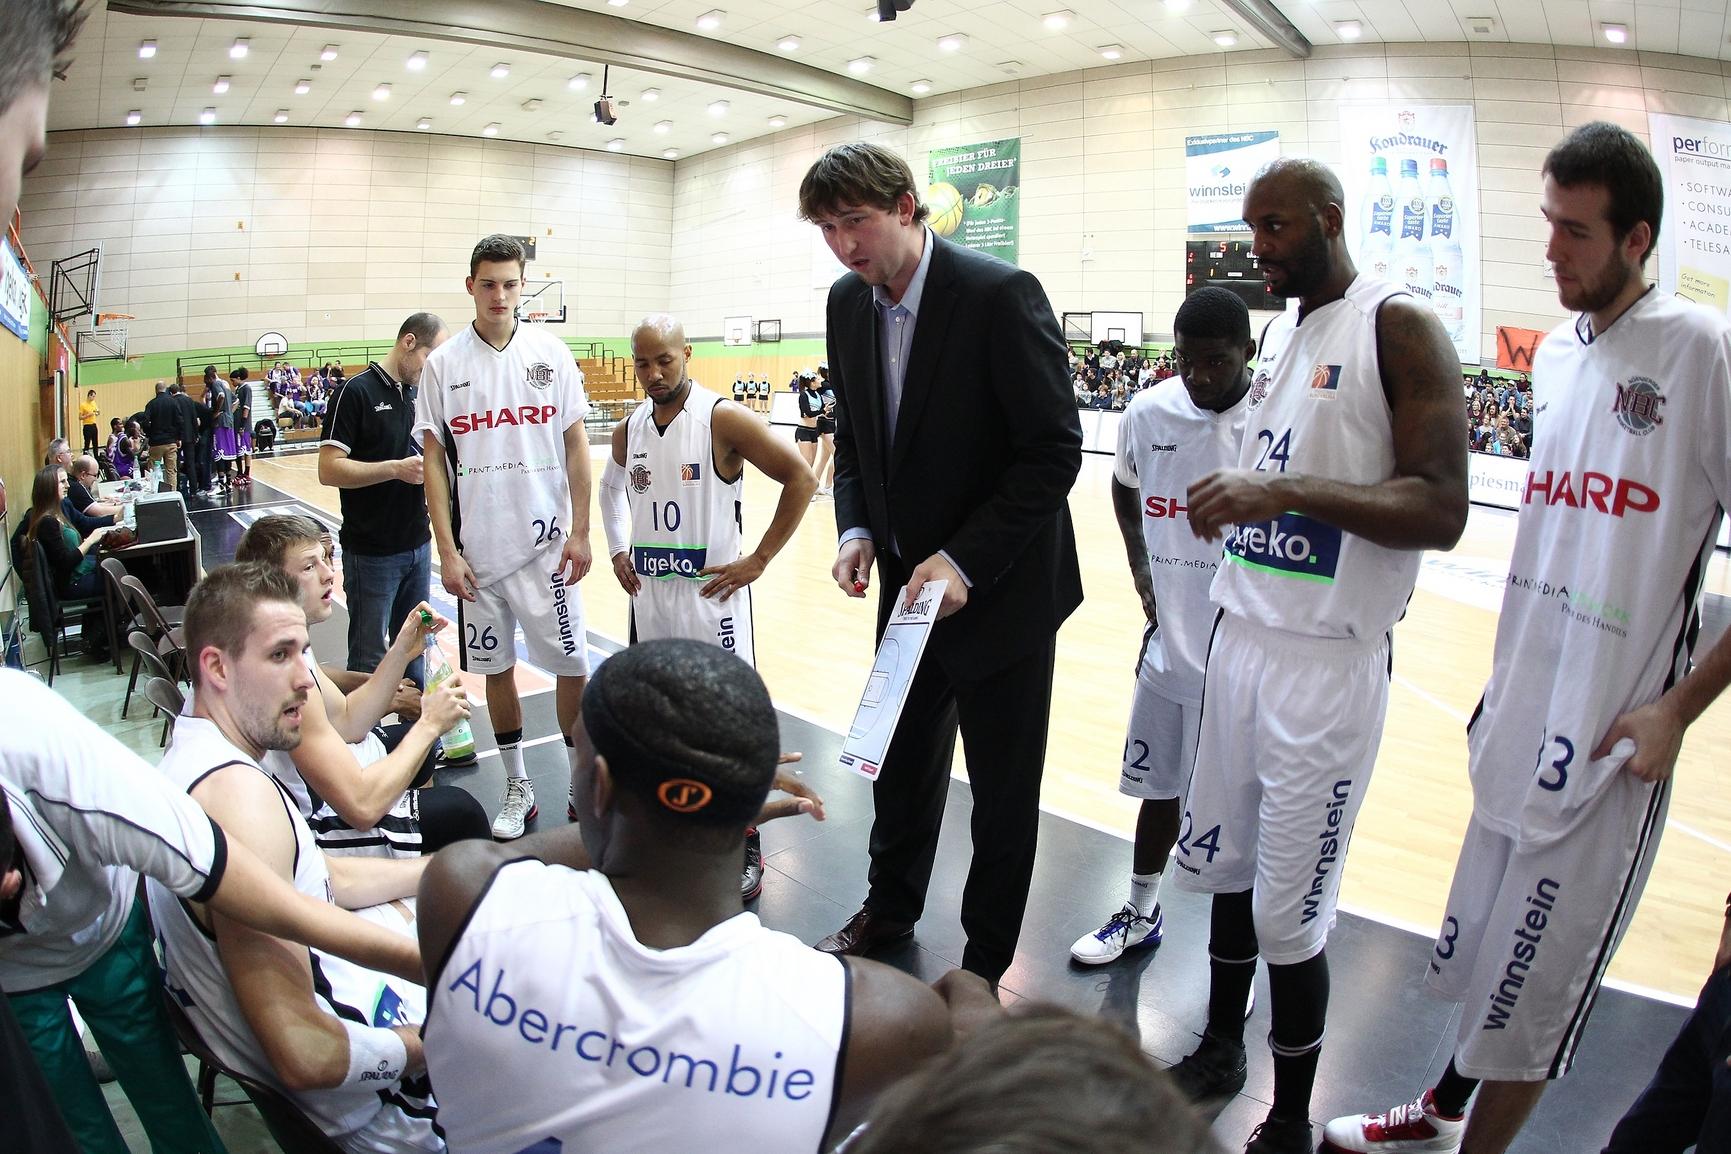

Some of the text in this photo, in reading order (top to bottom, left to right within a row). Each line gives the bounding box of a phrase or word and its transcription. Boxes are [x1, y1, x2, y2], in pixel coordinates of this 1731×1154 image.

[977, 148, 996, 159] FÜR
[1370, 132, 1448, 155] Kondrauer
[1674, 156, 1694, 164] paper
[1695, 158, 1719, 168] output
[1189, 182, 1249, 197] winnstei
[1689, 221, 1731, 236] ACADE
[1434, 281, 1462, 298] drauer
[1681, 283, 1716, 298] information
[1695, 279, 1710, 287] more
[1499, 328, 1538, 366] W
[450, 405, 557, 435] SHARP
[1151, 444, 1177, 452] SPALDING
[1256, 428, 1292, 472] 24
[1523, 470, 1661, 518] HARP
[532, 516, 561, 547] 26
[652, 501, 681, 532] 10
[550, 572, 576, 656] winnstein
[467, 622, 498, 651] 26
[1177, 810, 1221, 864] 24
[1301, 778, 1352, 925] winnstein
[1436, 915, 1458, 960] 3
[1483, 877, 1561, 1031] winnstein
[449, 957, 815, 1100] Abercrombie
